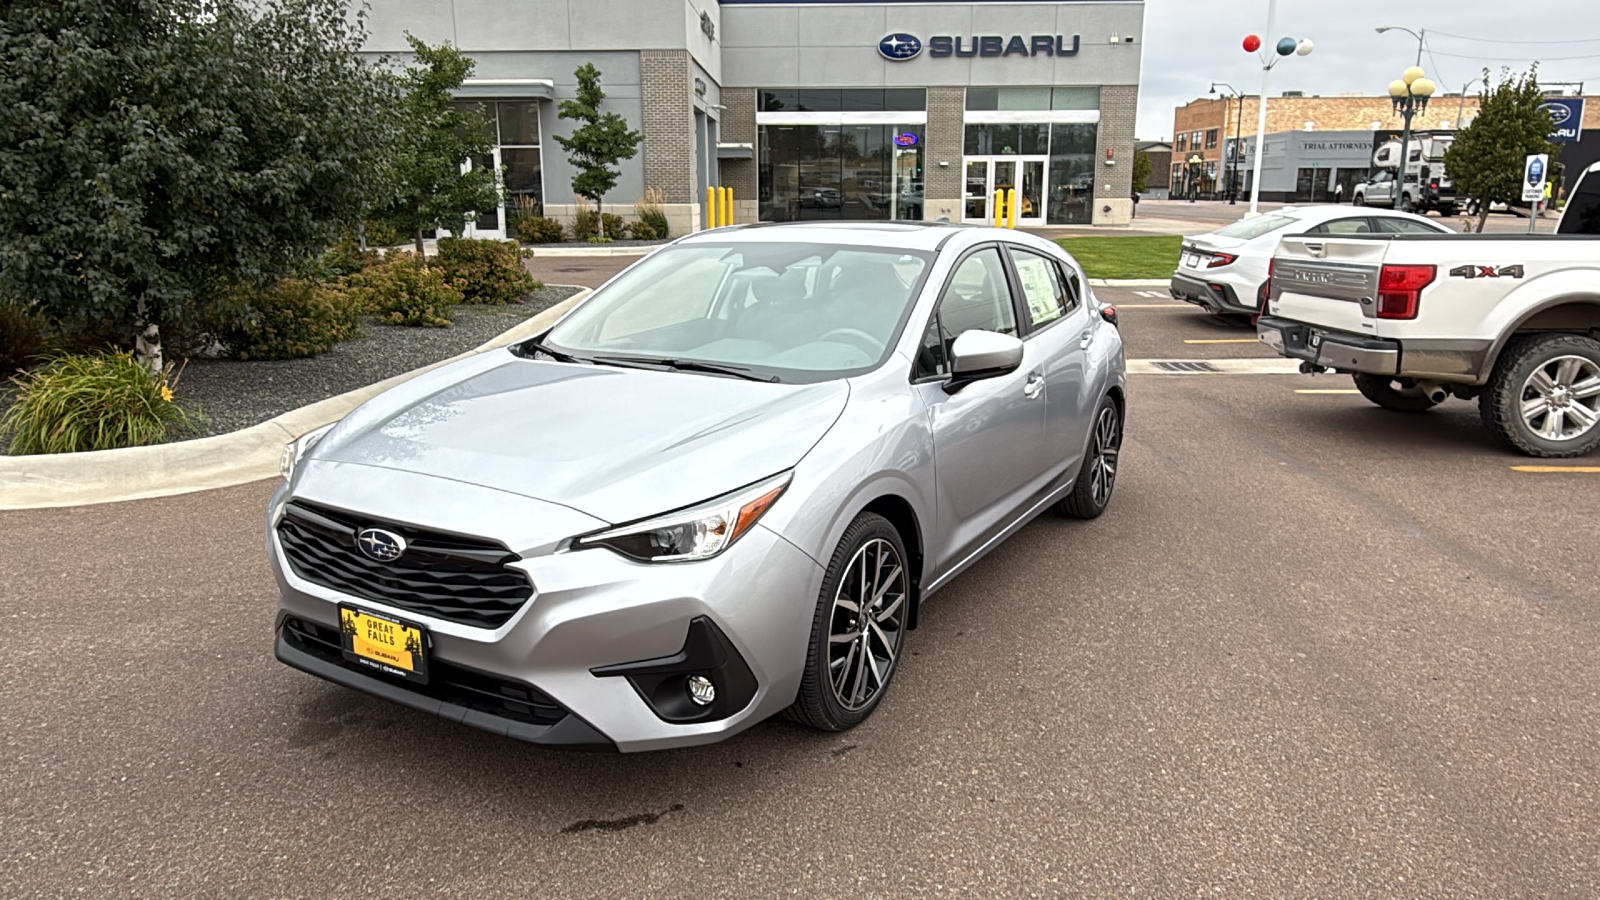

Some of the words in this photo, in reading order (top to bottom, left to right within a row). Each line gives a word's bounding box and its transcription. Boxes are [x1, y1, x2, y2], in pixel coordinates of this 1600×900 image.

[929, 35, 1080, 58] SUBARU
[367, 619, 394, 634] GREAT
[367, 630, 395, 646] FALLS
[374, 650, 400, 662] SUBARU
